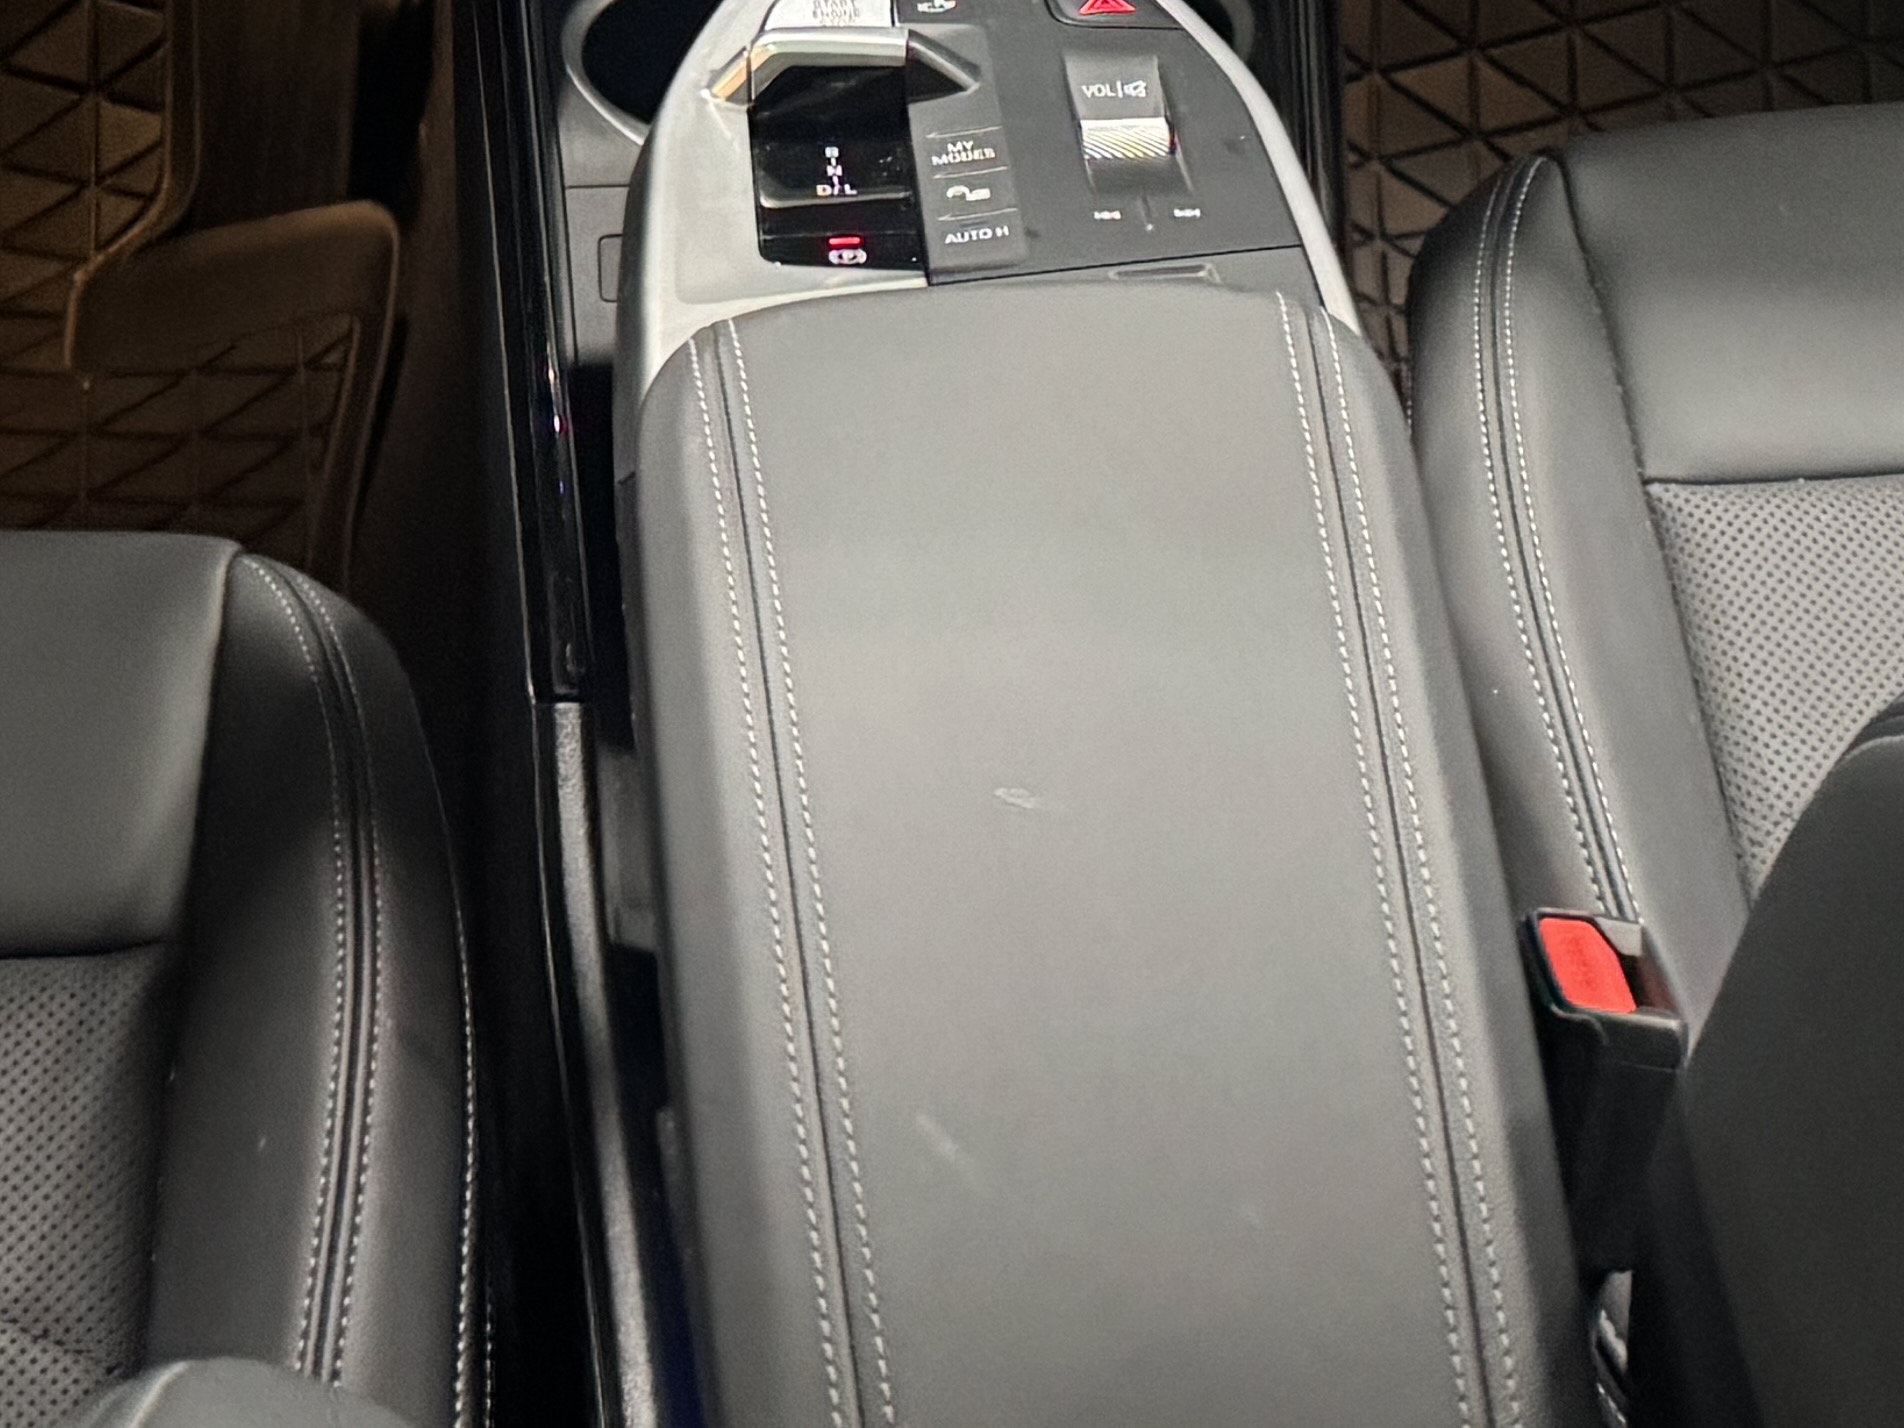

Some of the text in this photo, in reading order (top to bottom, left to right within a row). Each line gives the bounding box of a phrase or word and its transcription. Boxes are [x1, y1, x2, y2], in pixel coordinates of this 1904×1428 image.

[1081, 84, 1116, 98] VOL
[947, 140, 974, 152] MY
[944, 228, 992, 244] AUTO
